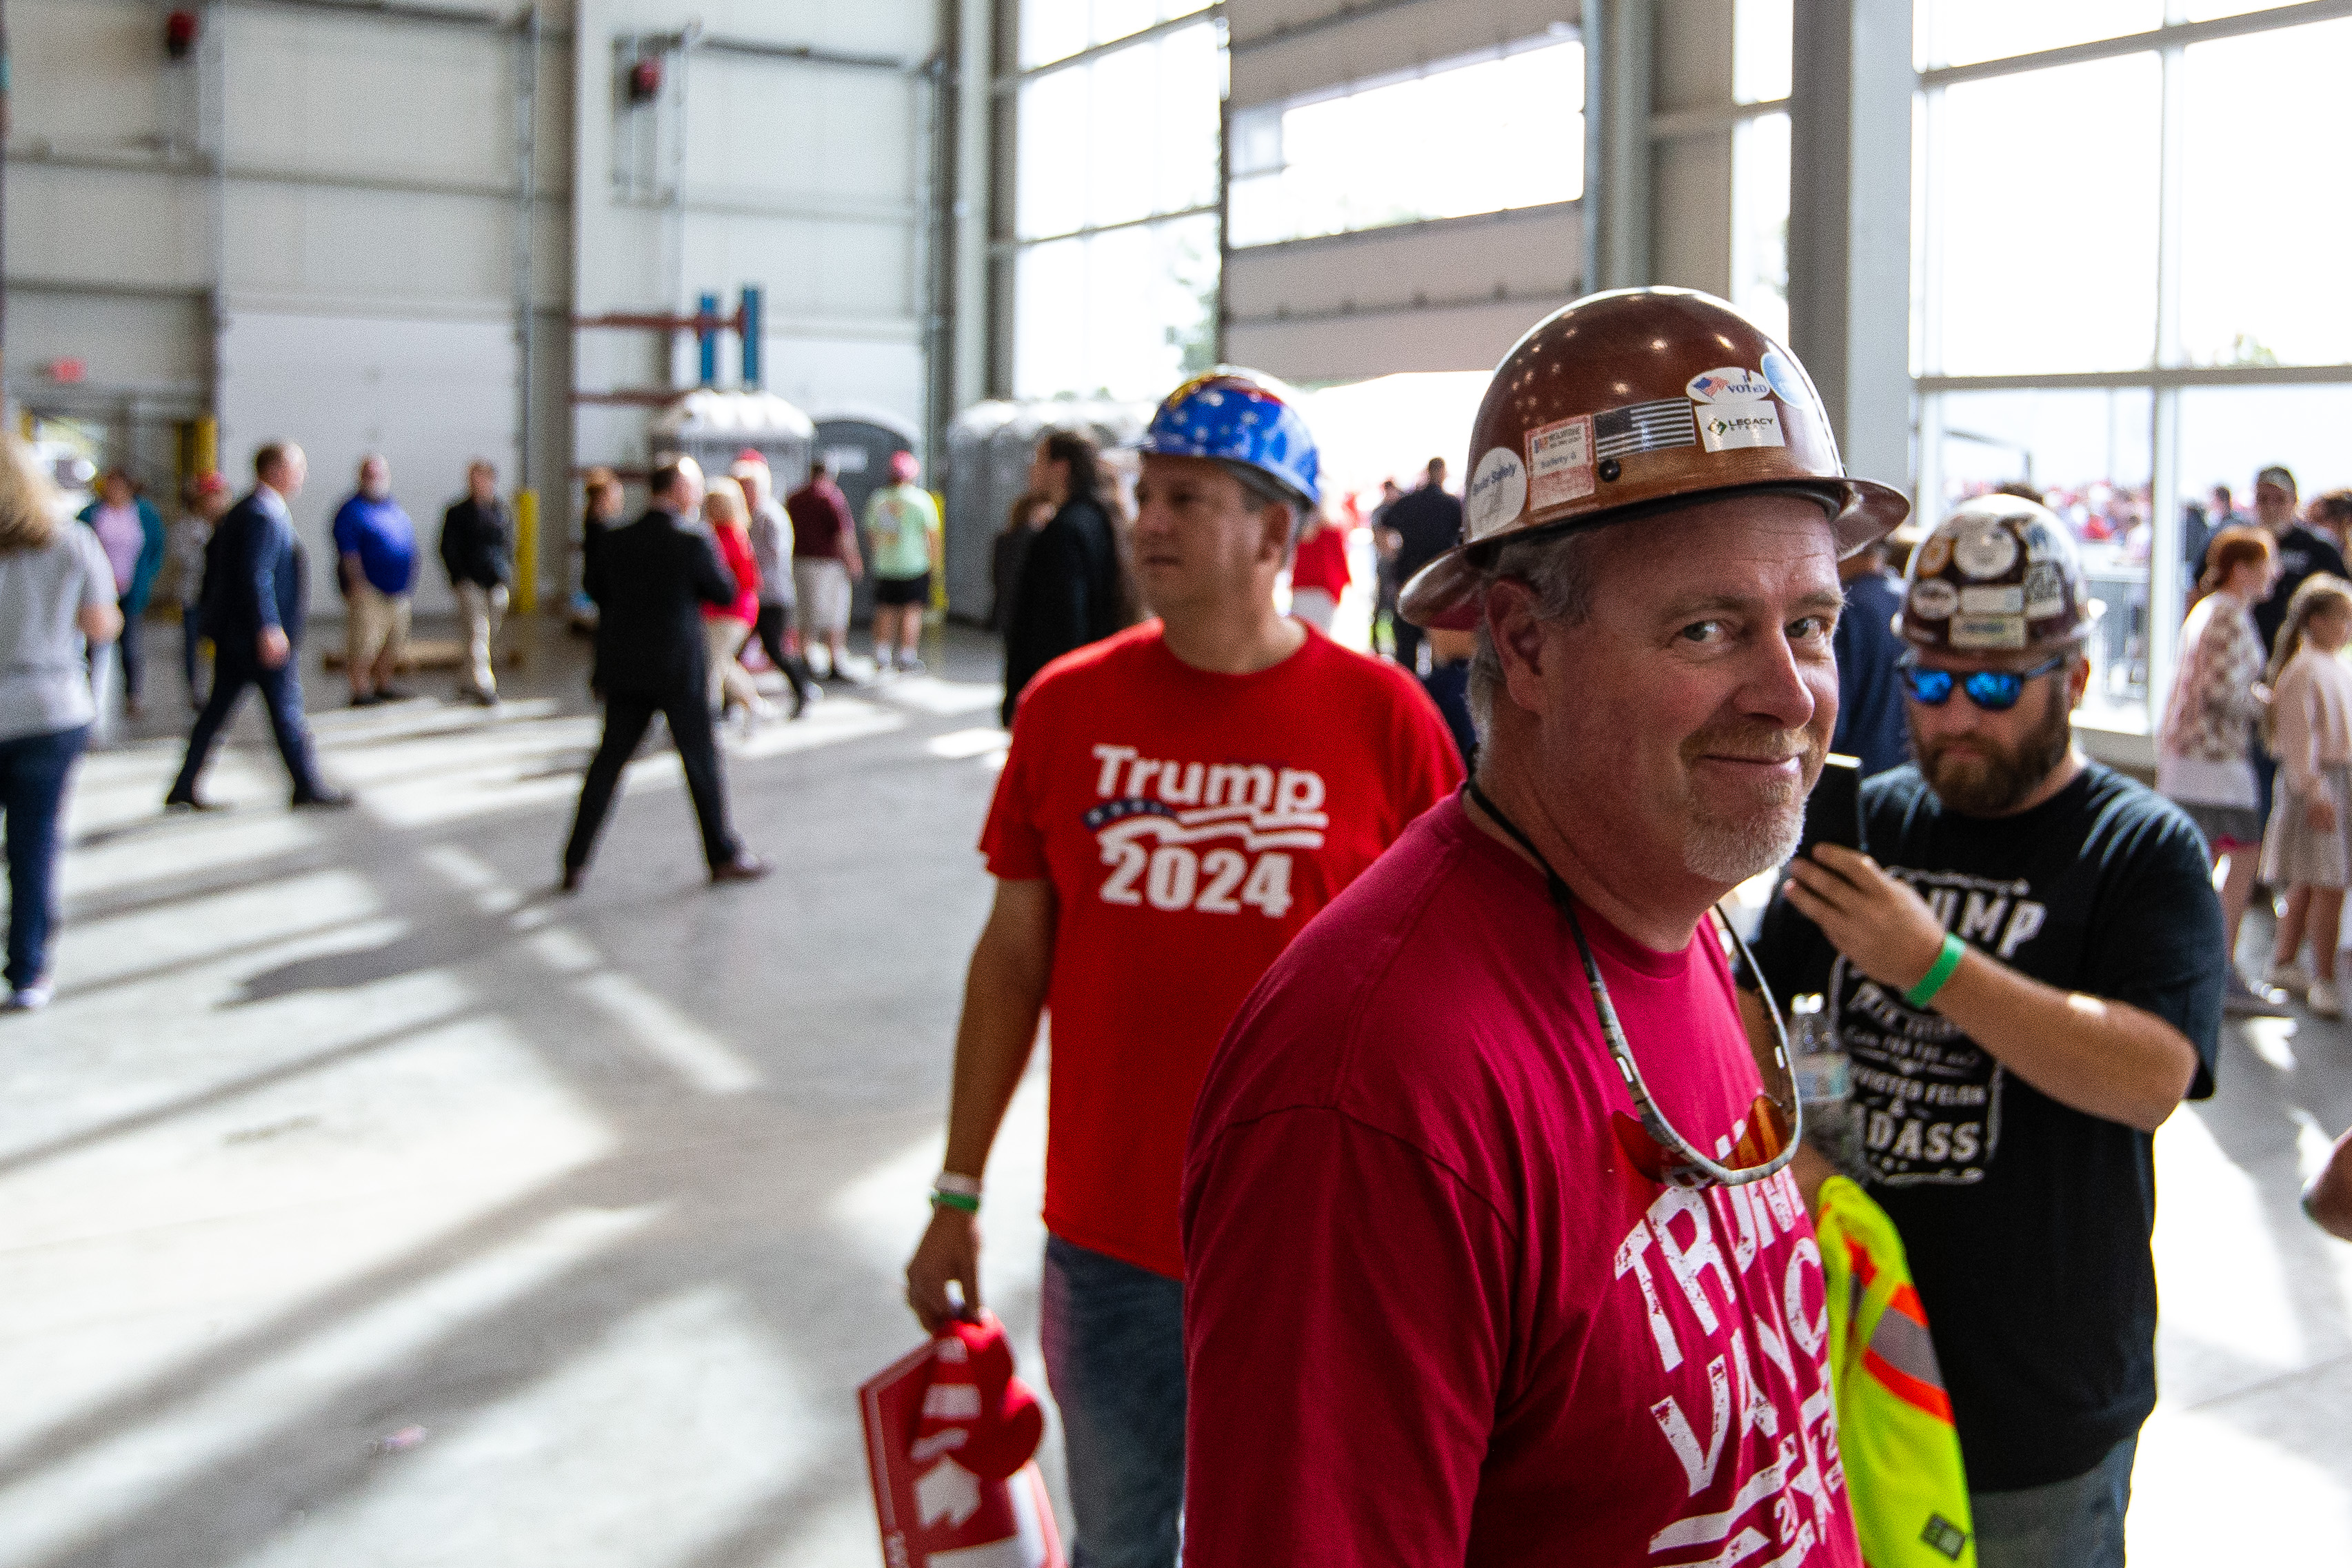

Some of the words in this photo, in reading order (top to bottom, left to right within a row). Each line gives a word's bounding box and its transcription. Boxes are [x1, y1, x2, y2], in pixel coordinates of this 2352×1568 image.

[1728, 417, 1773, 428] LEGACY
[1093, 743, 1325, 816] Trump
[1100, 841, 1294, 918] 2024
[1930, 888, 2047, 959] UMP
[1867, 1109, 1981, 1162] DASS
[1614, 1118, 1805, 1374] TRUM
[1650, 1236, 1830, 1497] VANC
